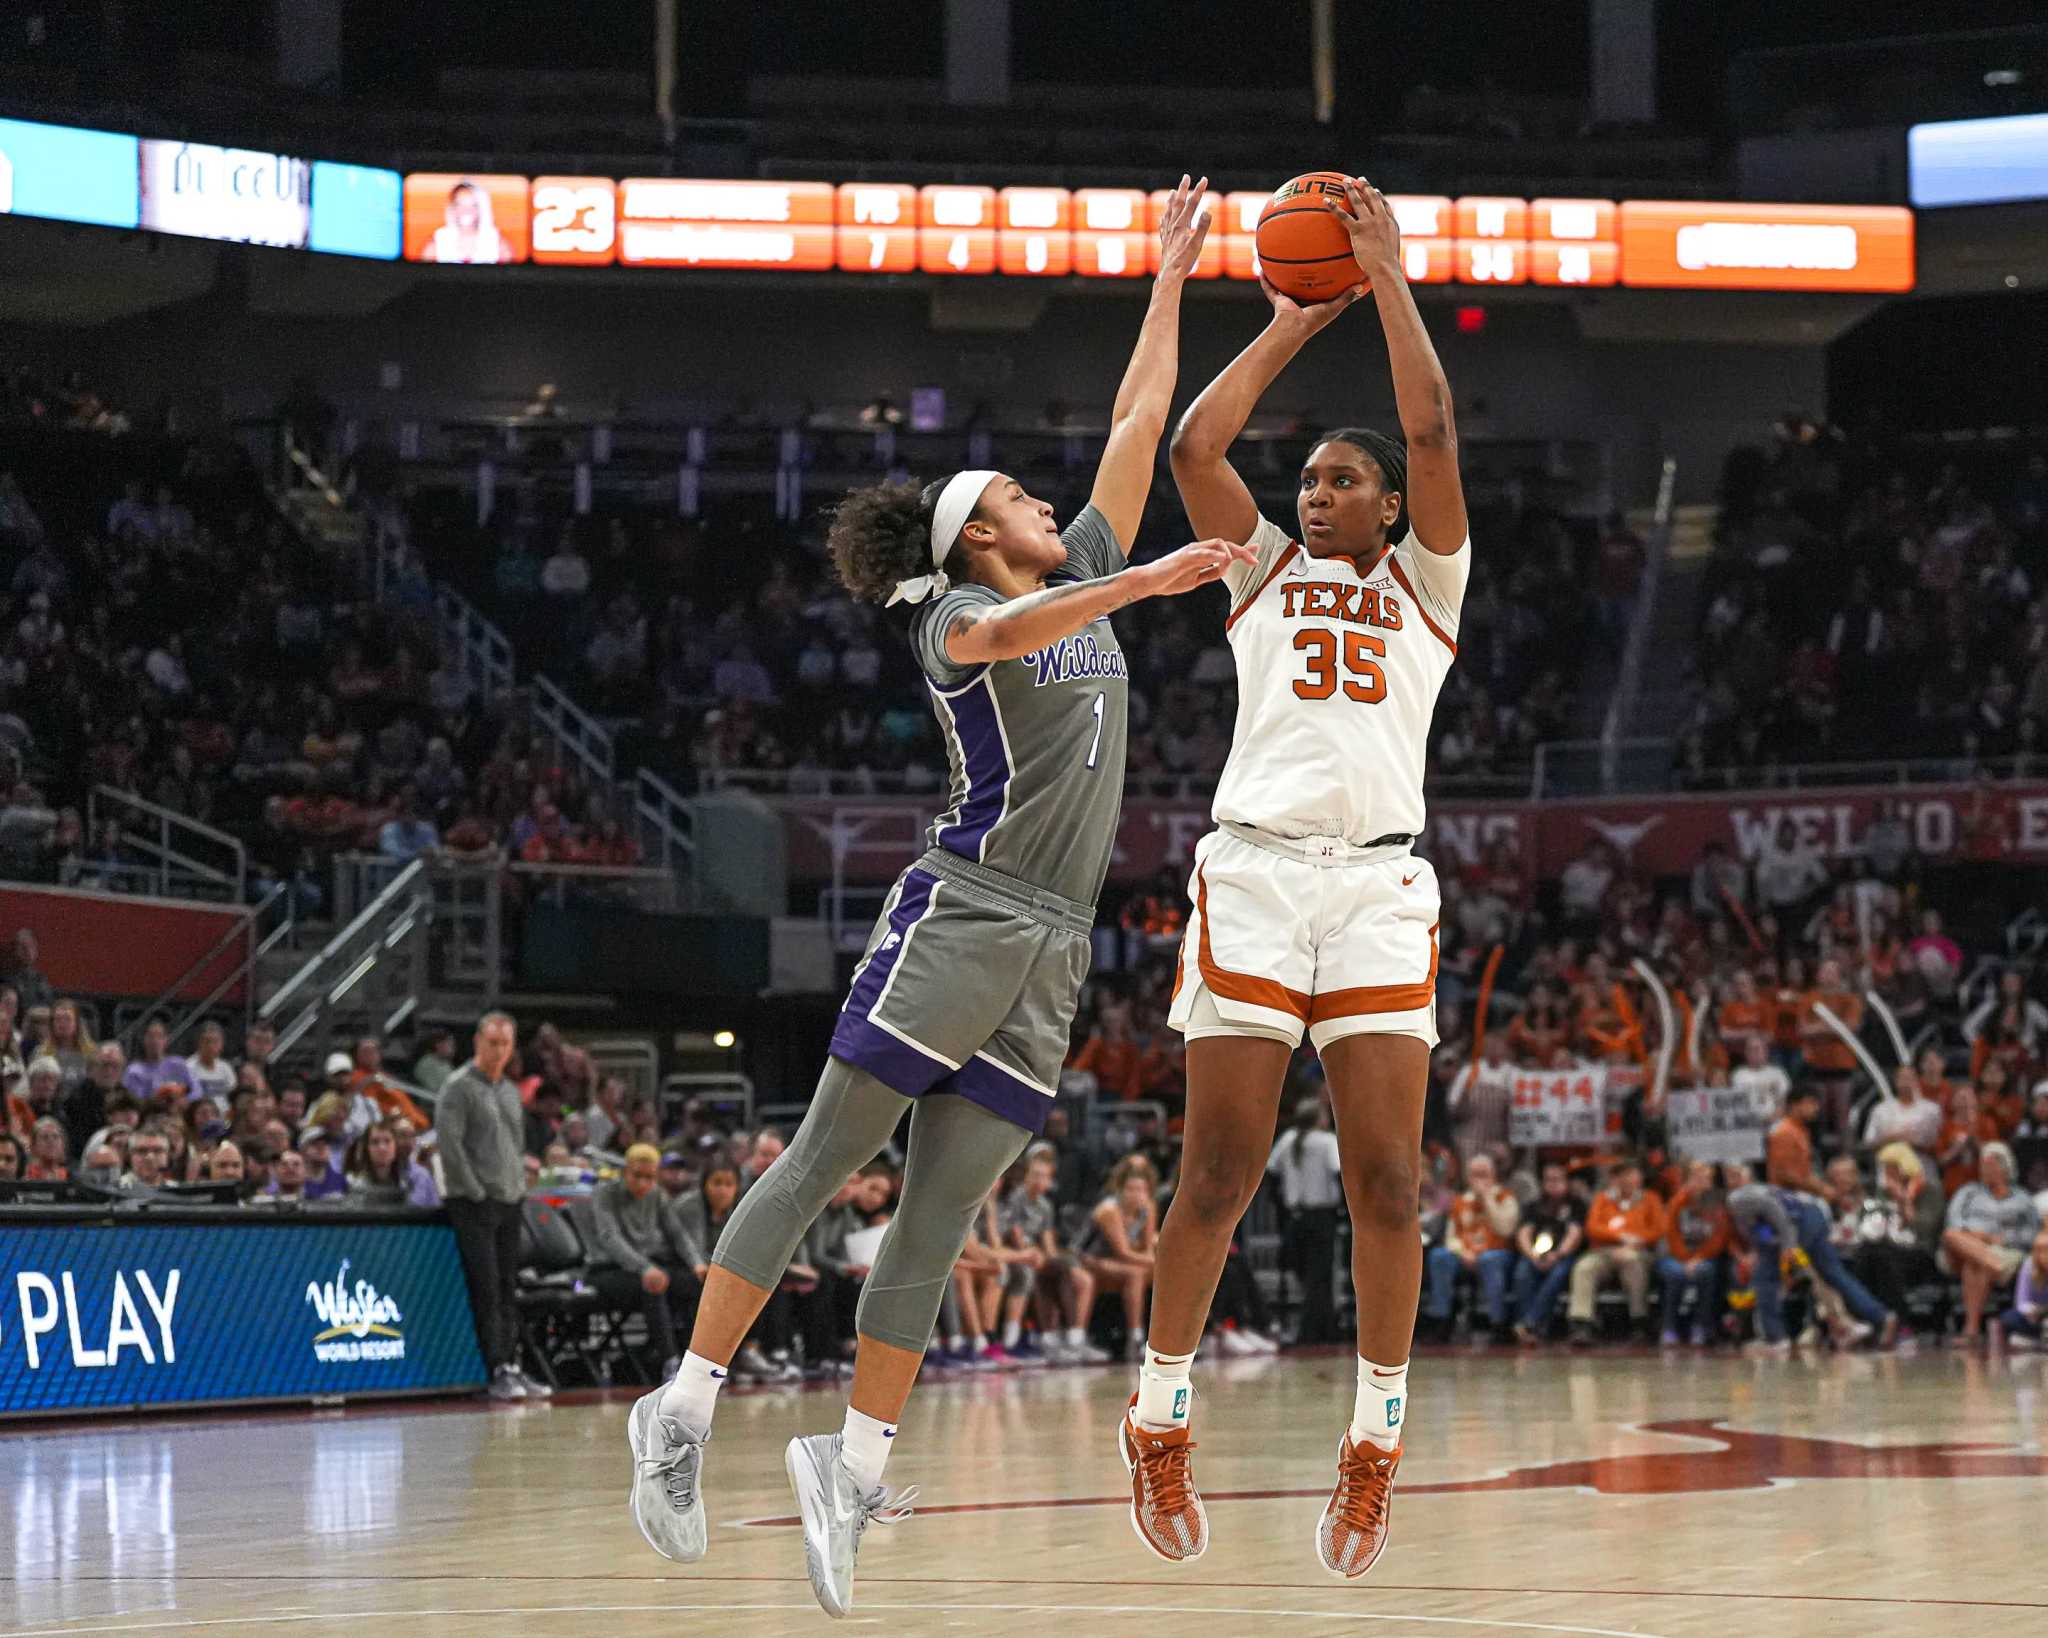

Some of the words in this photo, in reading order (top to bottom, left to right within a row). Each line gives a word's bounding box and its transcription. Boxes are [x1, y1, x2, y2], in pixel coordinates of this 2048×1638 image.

[533, 185, 615, 253] 23
[1275, 181, 1346, 201] ELITE
[1280, 581, 1403, 632] TEXAS
[1292, 628, 1388, 705] 35
[1085, 690, 1106, 770] 1
[1729, 797, 2048, 862] WELOE
[16, 1268, 181, 1370] PLAY
